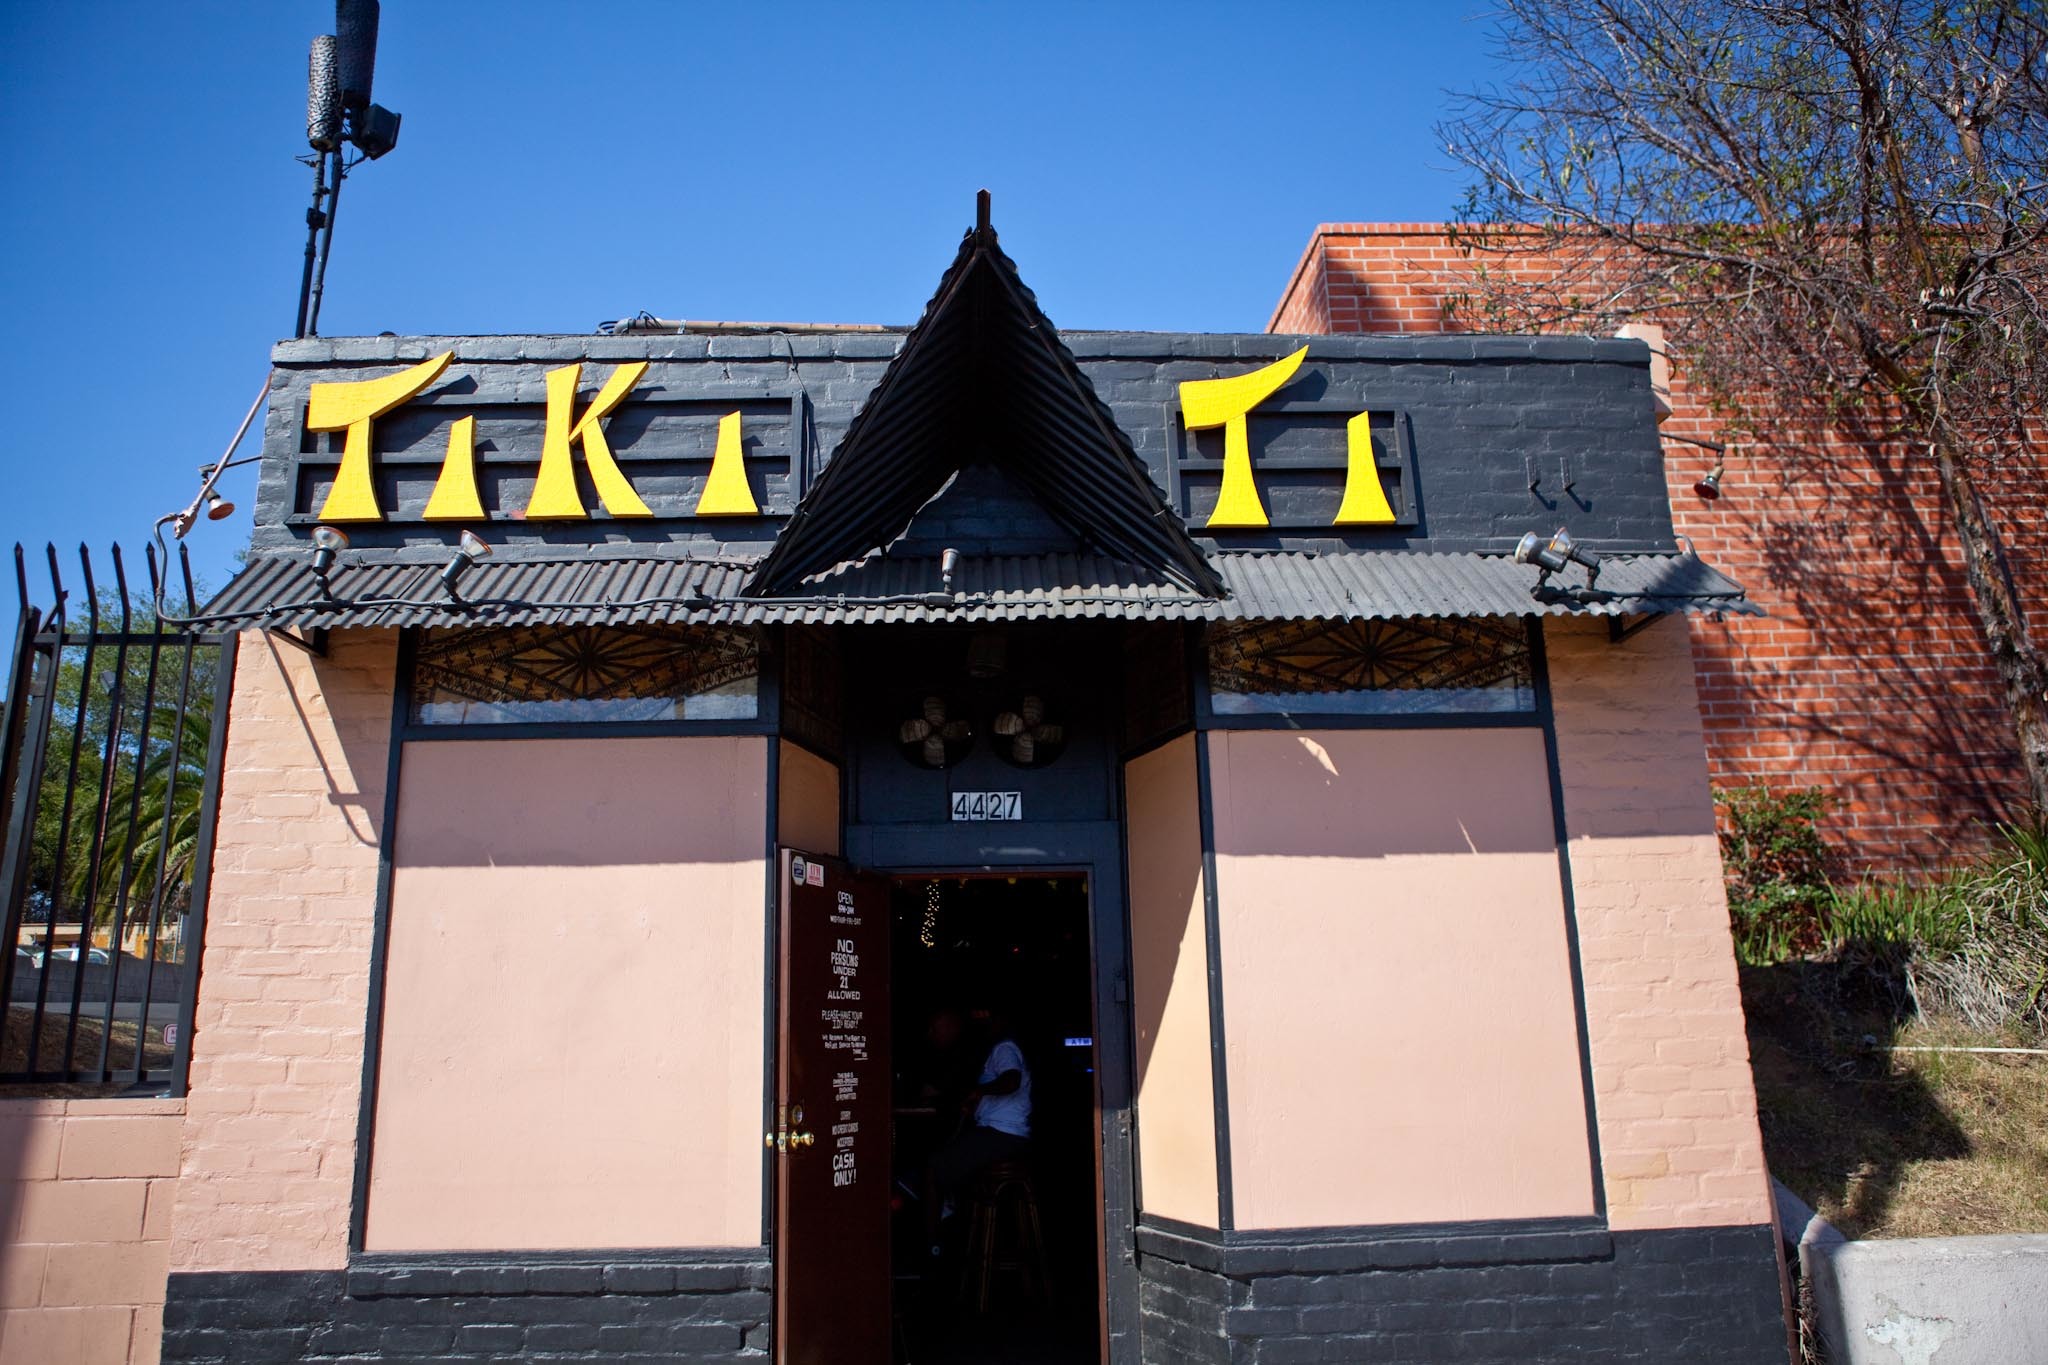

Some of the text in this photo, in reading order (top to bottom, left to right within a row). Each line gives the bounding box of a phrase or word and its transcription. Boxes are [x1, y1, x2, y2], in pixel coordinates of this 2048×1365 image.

[953, 793, 1019, 819] 4427
[837, 890, 854, 906] OPEN
[837, 939, 854, 954] NO
[830, 951, 859, 968] PERSONS
[832, 965, 857, 977] UNDER
[839, 975, 849, 989] 21
[827, 990, 861, 1000] ALLOWED
[832, 1152, 855, 1171] CASH
[833, 1168, 857, 1187] ONLY!
